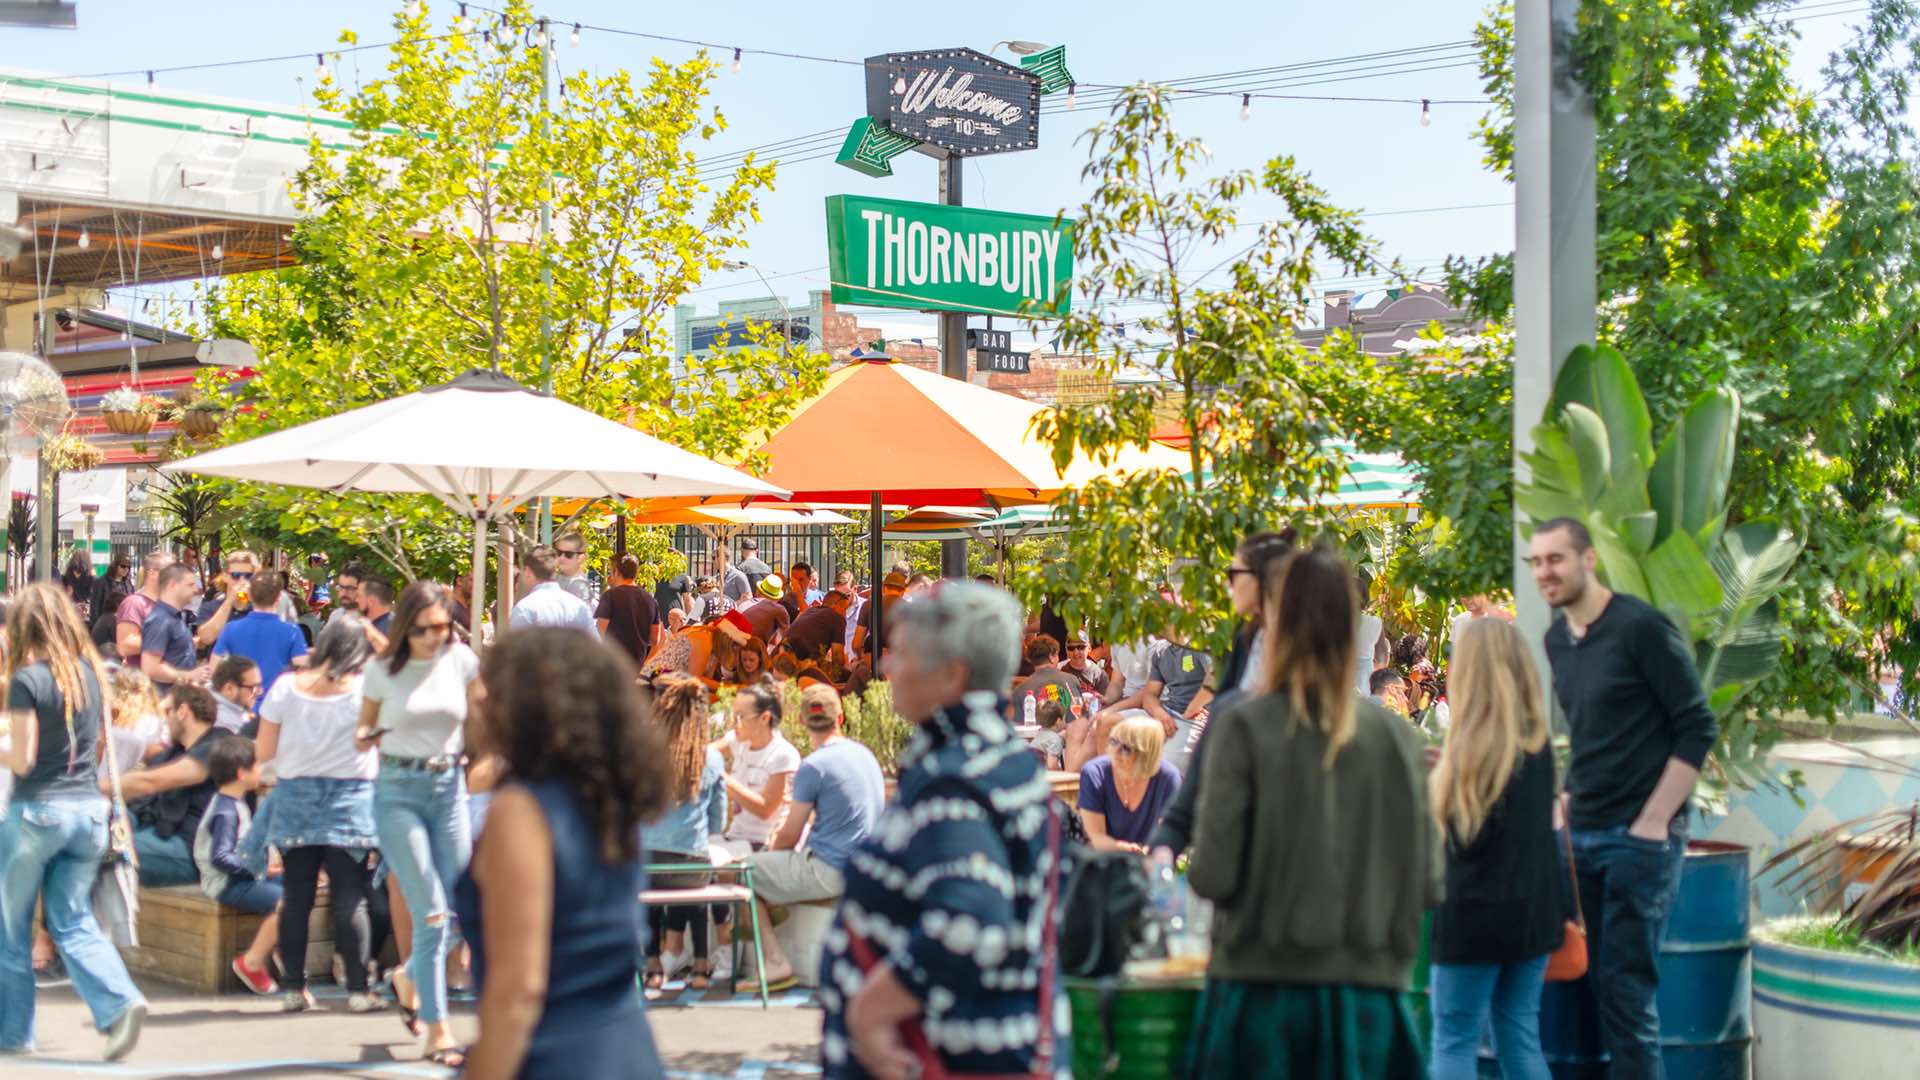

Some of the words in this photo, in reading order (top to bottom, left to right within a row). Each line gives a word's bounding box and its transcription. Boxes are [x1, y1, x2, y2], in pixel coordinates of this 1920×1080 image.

[901, 66, 1024, 125] Welcome
[954, 119, 975, 135] TO
[861, 209, 1060, 303] THORNBURY
[983, 333, 1005, 348] BAR
[995, 354, 1024, 370] FOOD
